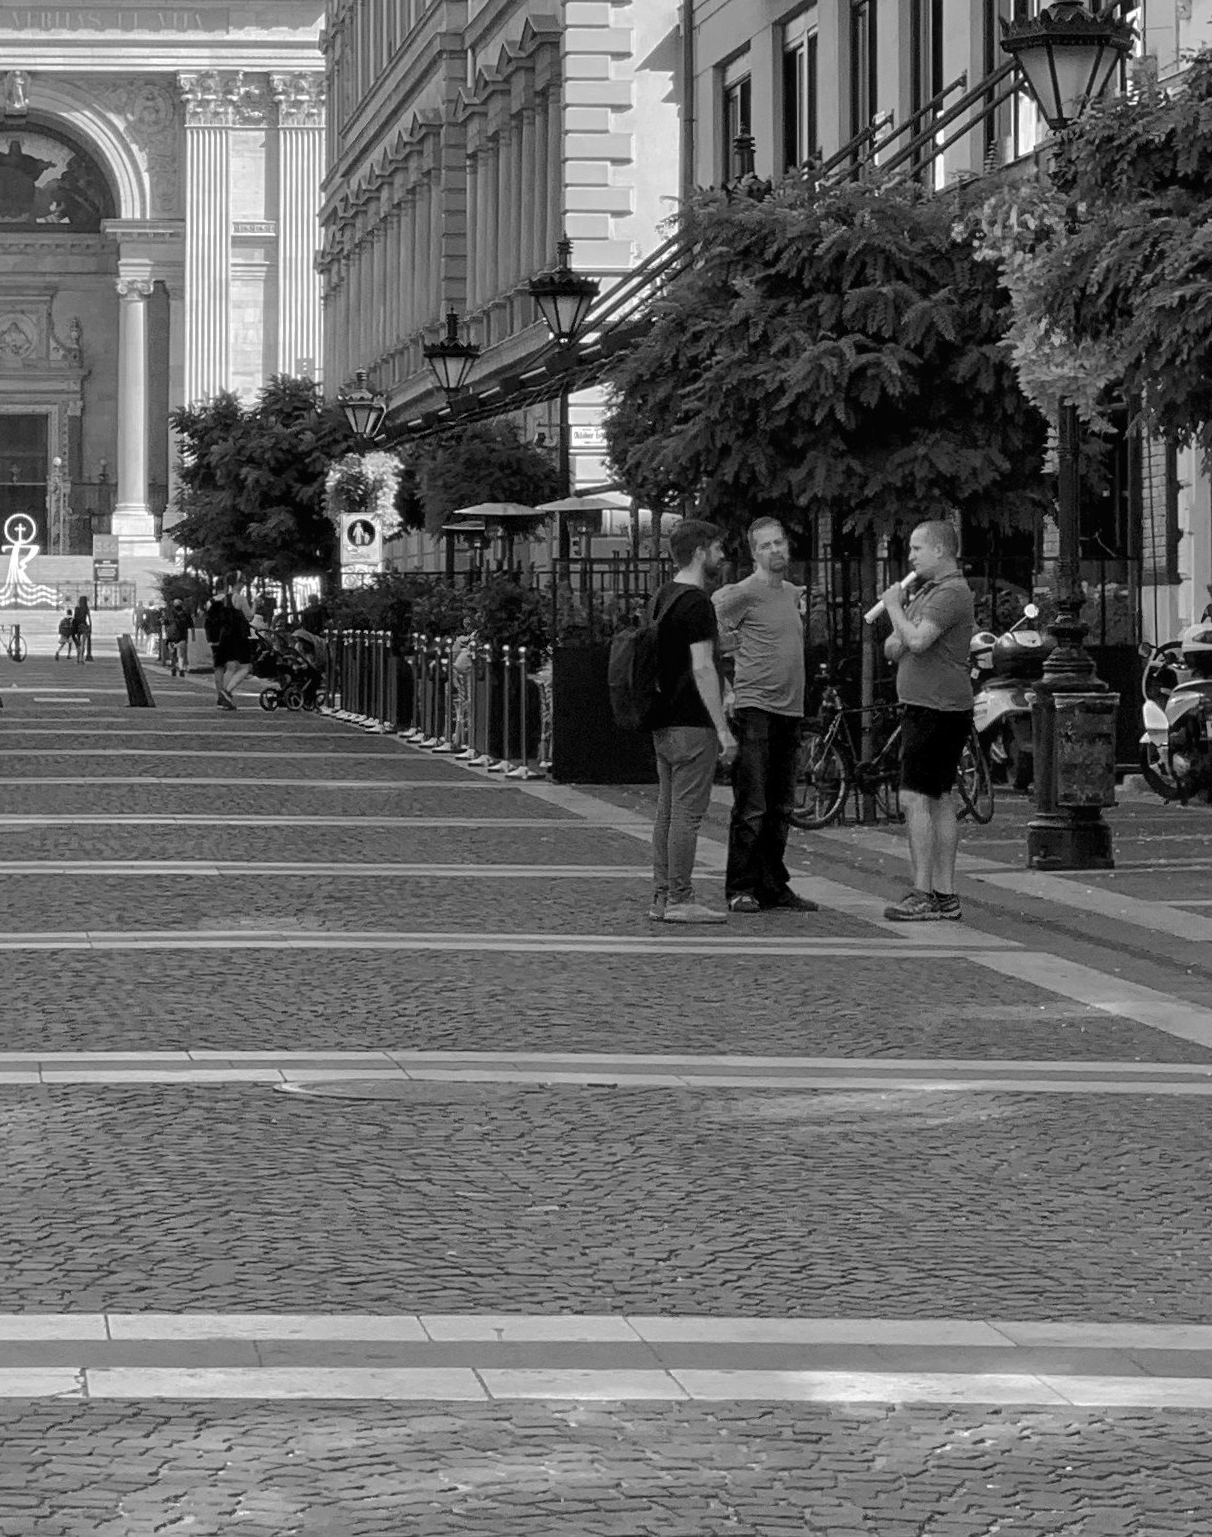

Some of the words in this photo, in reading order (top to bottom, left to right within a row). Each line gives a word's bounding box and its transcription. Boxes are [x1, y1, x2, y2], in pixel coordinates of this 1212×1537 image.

[11, 10, 103, 28] VERITAS
[116, 11, 144, 28] ET
[157, 11, 206, 29] VITA
[95, 542, 118, 552] 356
